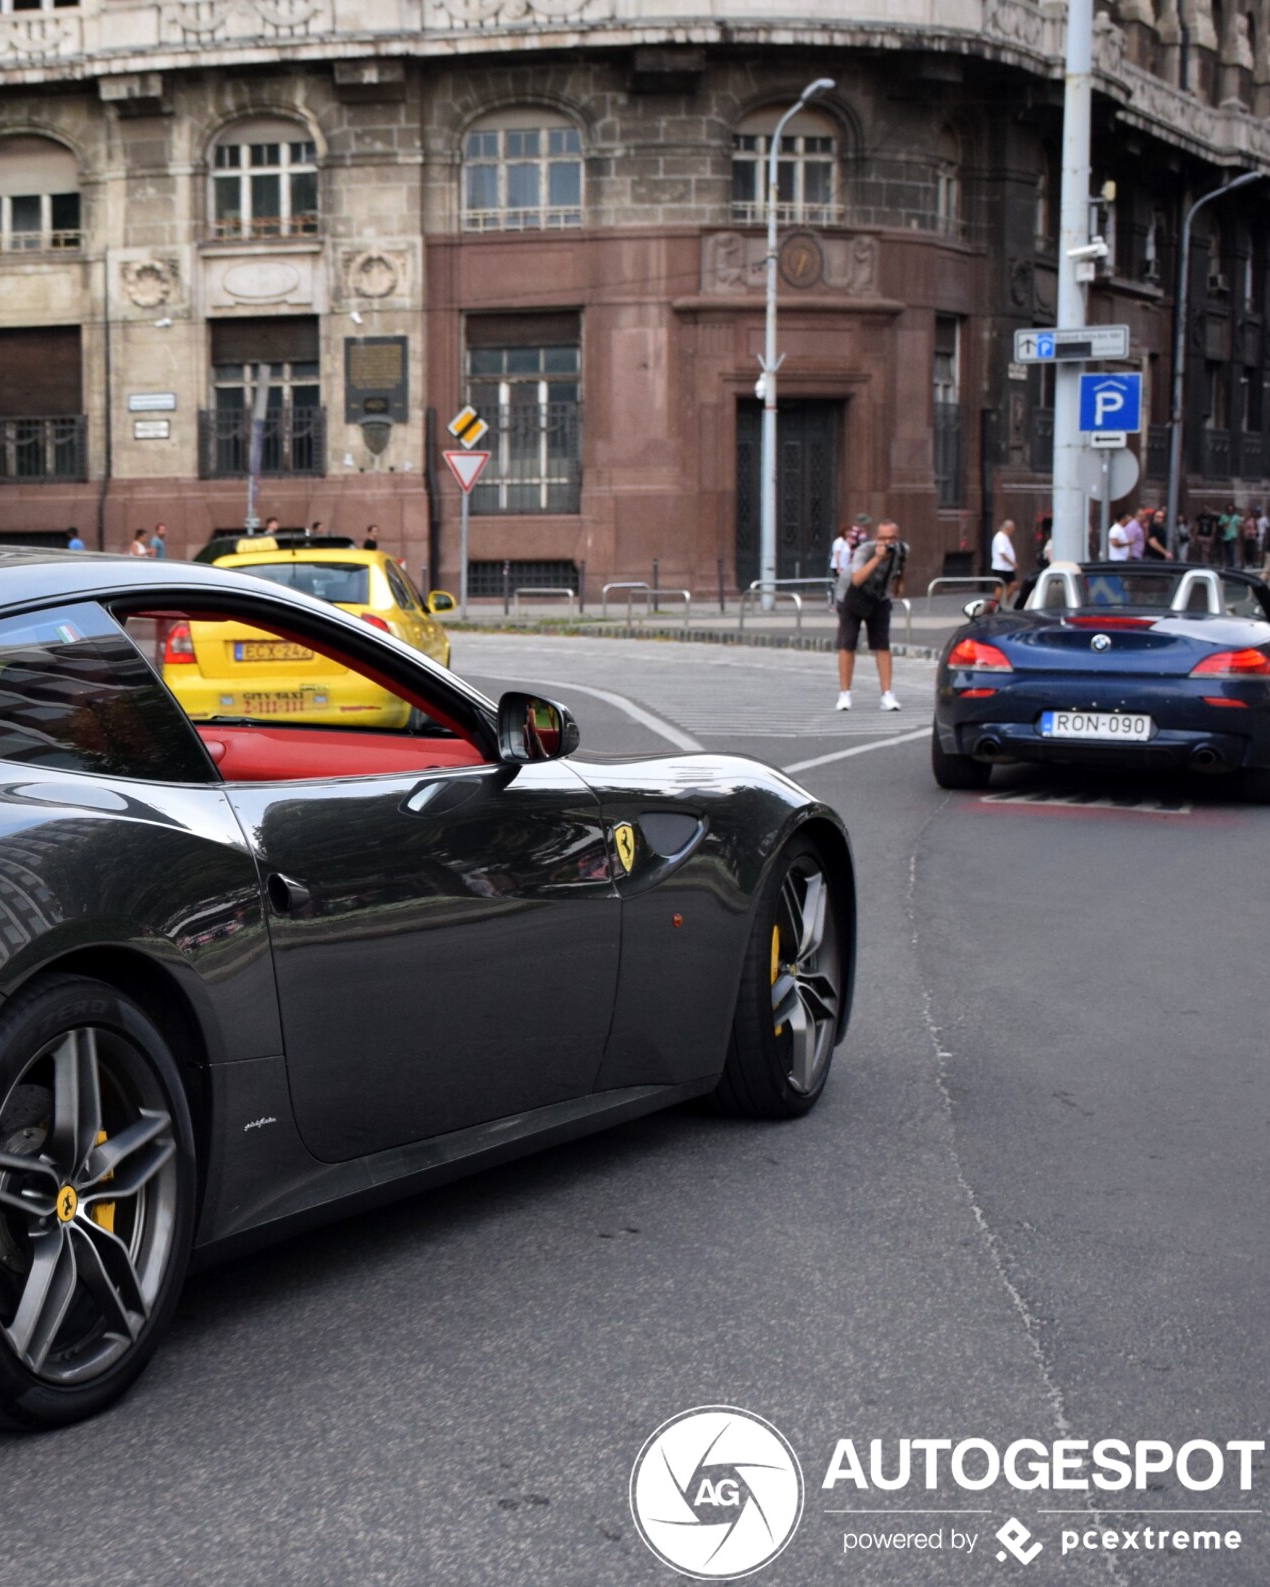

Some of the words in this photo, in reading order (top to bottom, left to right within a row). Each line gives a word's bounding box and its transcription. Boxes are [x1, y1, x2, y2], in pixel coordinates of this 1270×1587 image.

[1094, 391, 1124, 426] P
[246, 642, 311, 659] ECX-242
[275, 692, 304, 700] TAXI
[1057, 714, 1145, 734] RON-090
